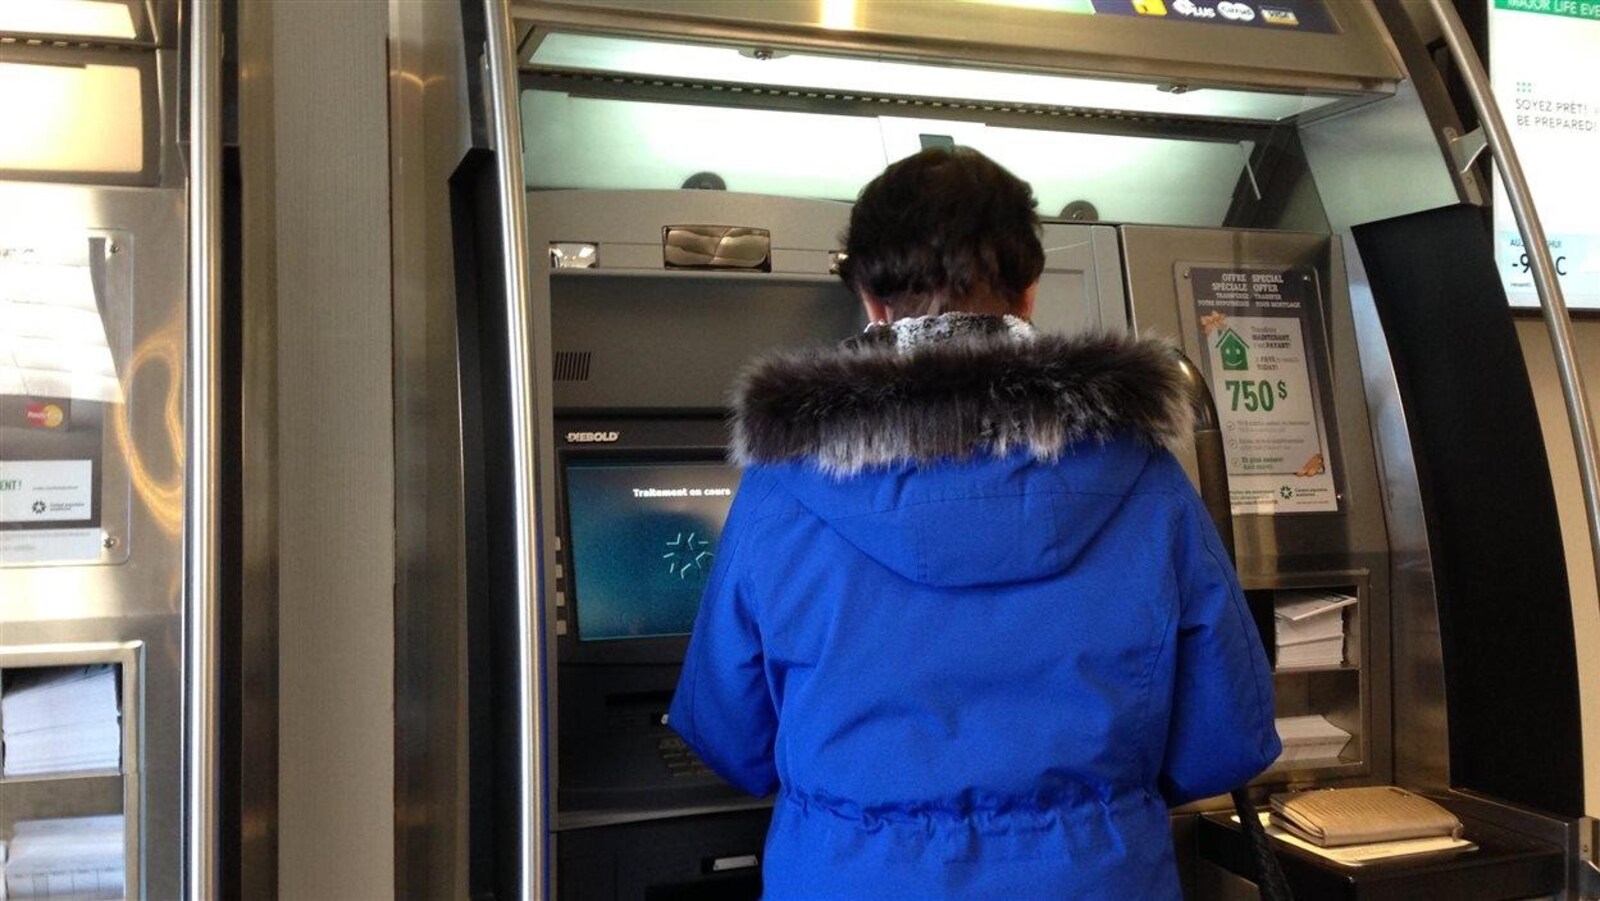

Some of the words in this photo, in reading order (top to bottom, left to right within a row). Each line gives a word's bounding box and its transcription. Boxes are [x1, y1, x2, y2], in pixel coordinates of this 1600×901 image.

[1554, 0, 1577, 14] LIFE
[1516, 98, 1552, 112] SOYEZ
[1517, 115, 1530, 126] BE
[1534, 116, 1597, 132] PREPARED!
[1222, 273, 1247, 282] OFFRE
[1252, 273, 1284, 283] SPECIAL
[1253, 283, 1278, 292] OFFER
[1225, 380, 1274, 412] 750
[1277, 380, 1288, 400] $
[566, 432, 619, 442] DIEBOLD
[633, 488, 688, 498] Traitement
[704, 488, 731, 497] cours
